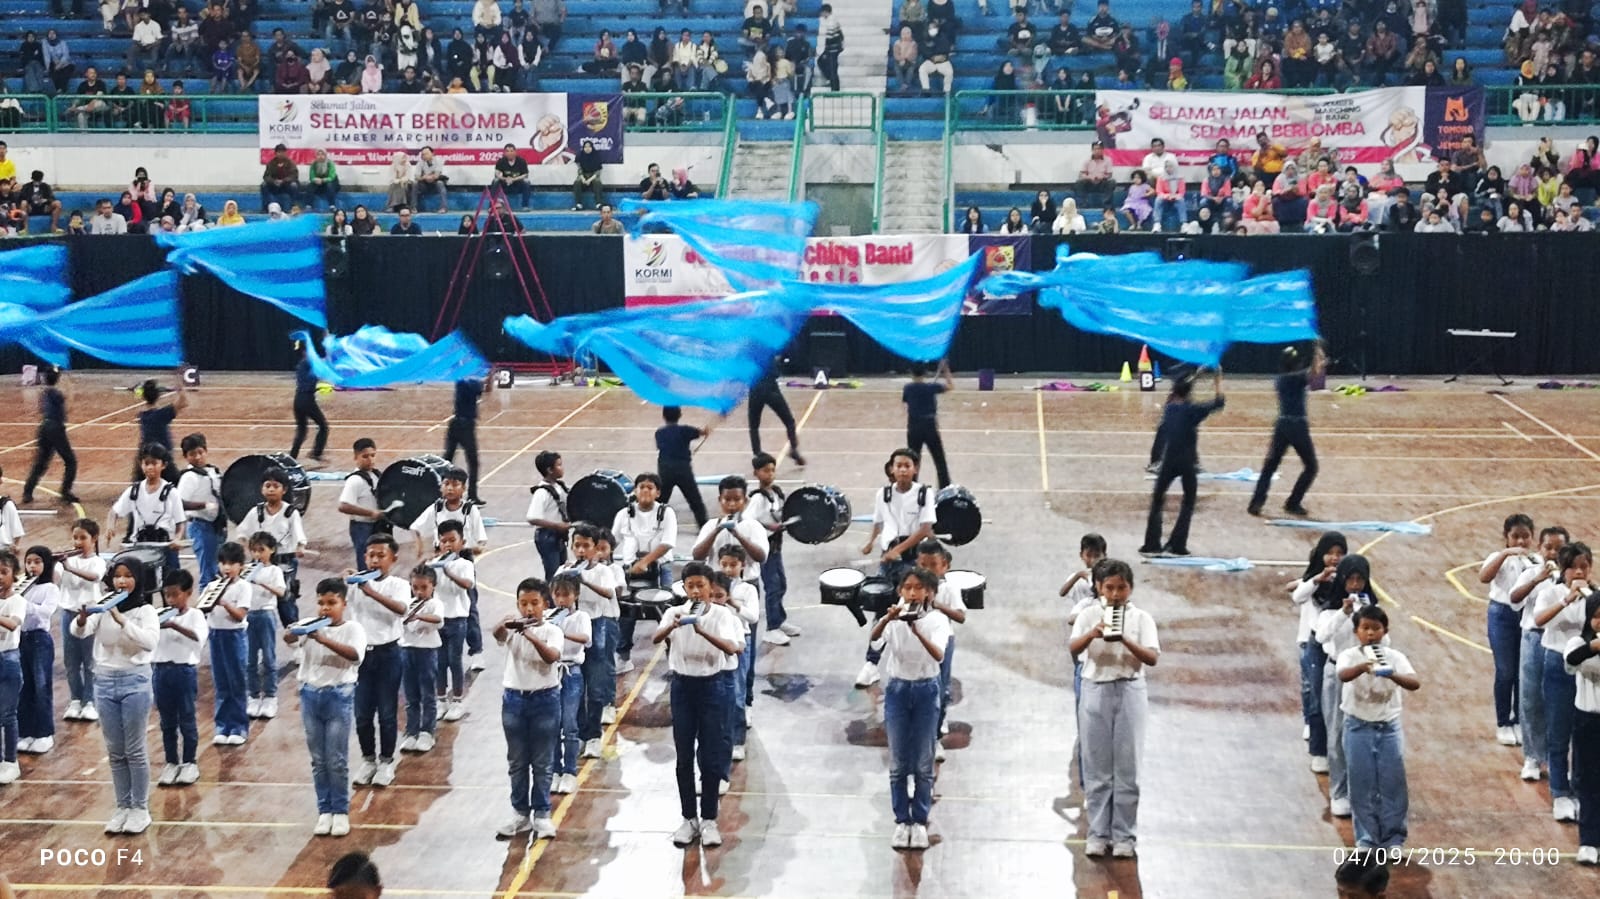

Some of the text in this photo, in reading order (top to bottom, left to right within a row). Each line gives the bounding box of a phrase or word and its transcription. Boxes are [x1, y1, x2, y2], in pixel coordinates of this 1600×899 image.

[310, 100, 377, 111] Selamat Jalan
[310, 112, 526, 129] SELAMAT BERLOMBA
[1149, 106, 1290, 121] SELAMAT JALAN,
[269, 124, 303, 133] KORMI
[1271, 121, 1366, 138] BERLOMBA
[1438, 124, 1474, 135] TOMORO
[325, 132, 504, 142] JEMBER MARCHING BAND
[1337, 150, 1357, 161] 025
[865, 241, 913, 265] Band
[635, 268, 673, 279] KORMI
[184, 368, 197, 383] C
[500, 370, 511, 385] B
[814, 369, 828, 385] A
[1142, 373, 1154, 388] B
